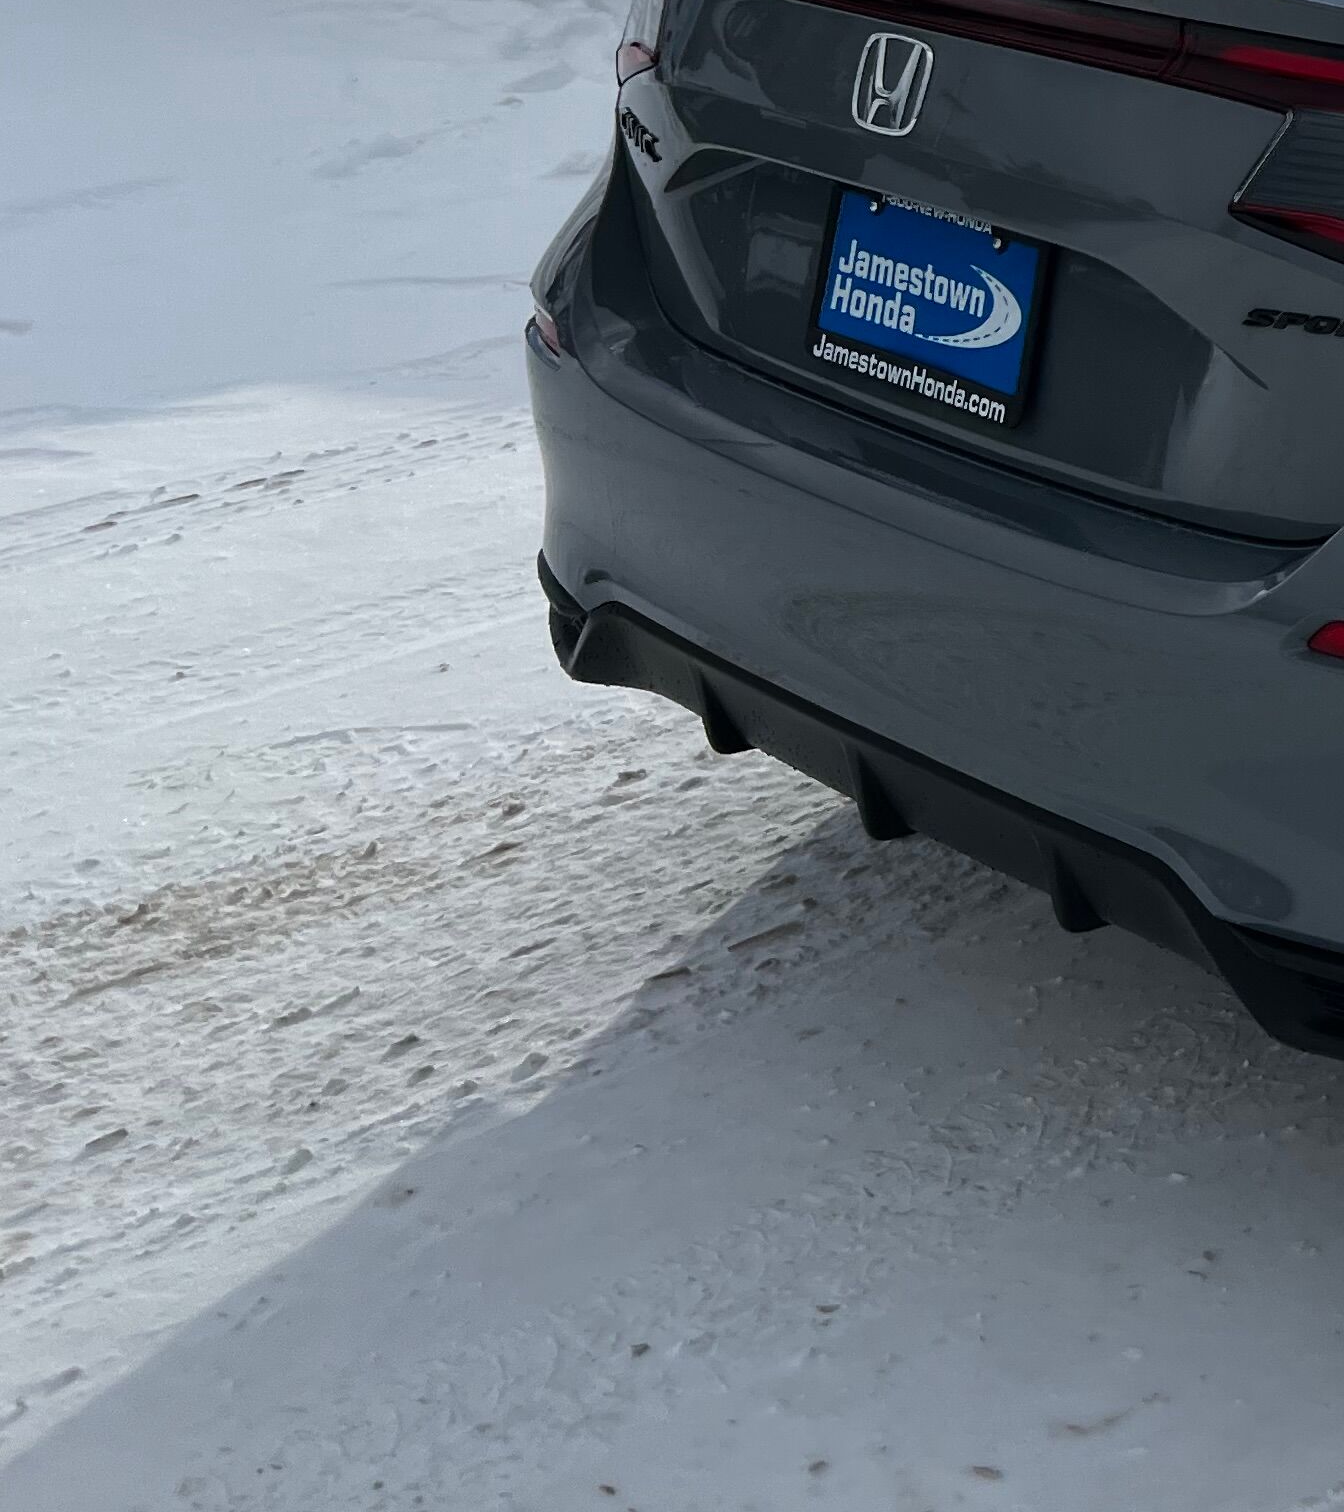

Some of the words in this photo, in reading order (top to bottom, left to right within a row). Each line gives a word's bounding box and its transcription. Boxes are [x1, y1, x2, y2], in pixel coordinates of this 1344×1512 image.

[830, 273, 917, 336] Honda
[838, 239, 987, 318] Jamestown
[812, 333, 1006, 424] JamestownHonda.com
